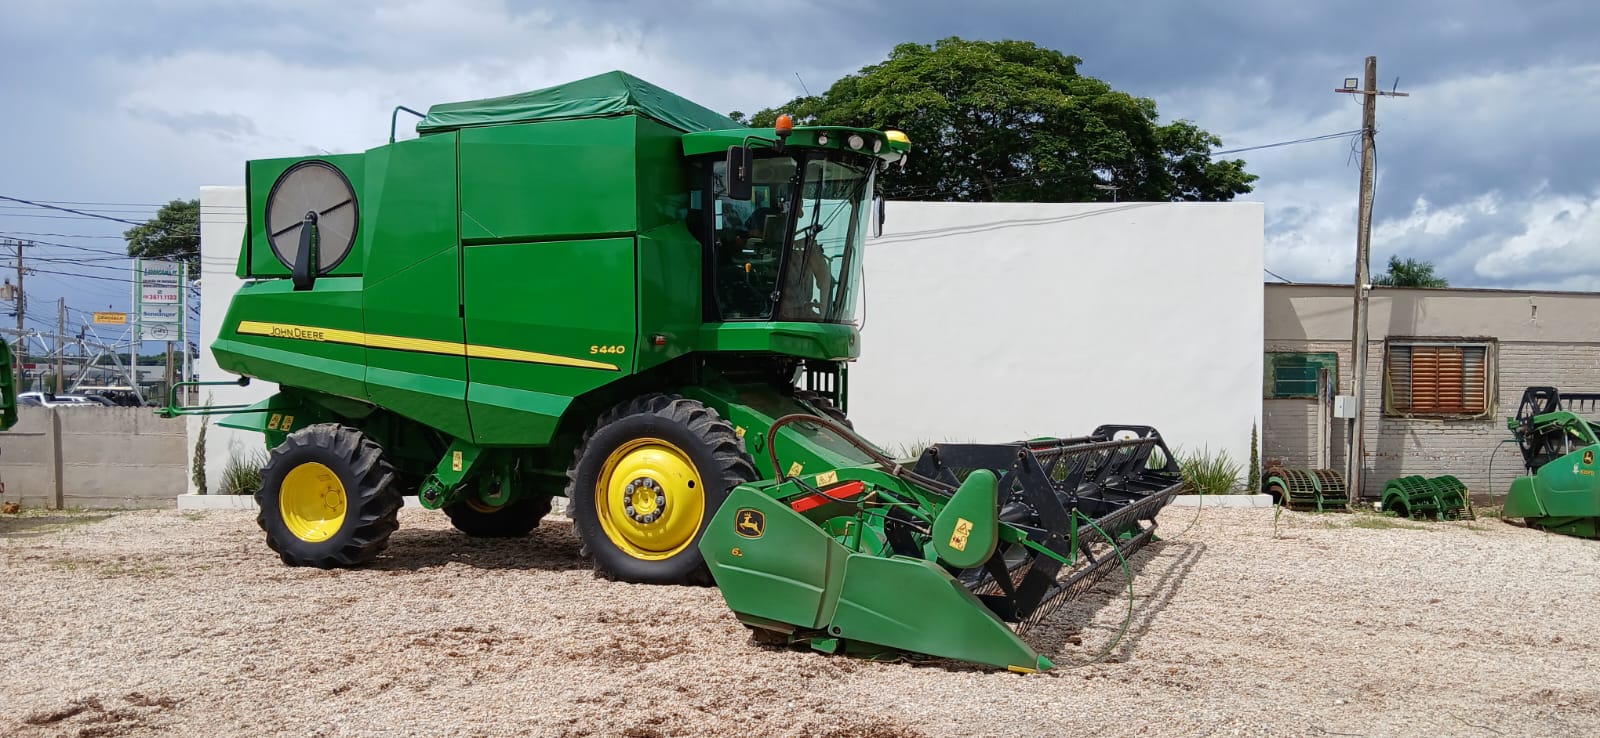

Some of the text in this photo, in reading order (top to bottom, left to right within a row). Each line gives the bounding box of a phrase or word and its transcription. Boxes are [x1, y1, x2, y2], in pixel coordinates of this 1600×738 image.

[271, 326, 325, 339] JOHN DEERE
[590, 345, 625, 354] S440
